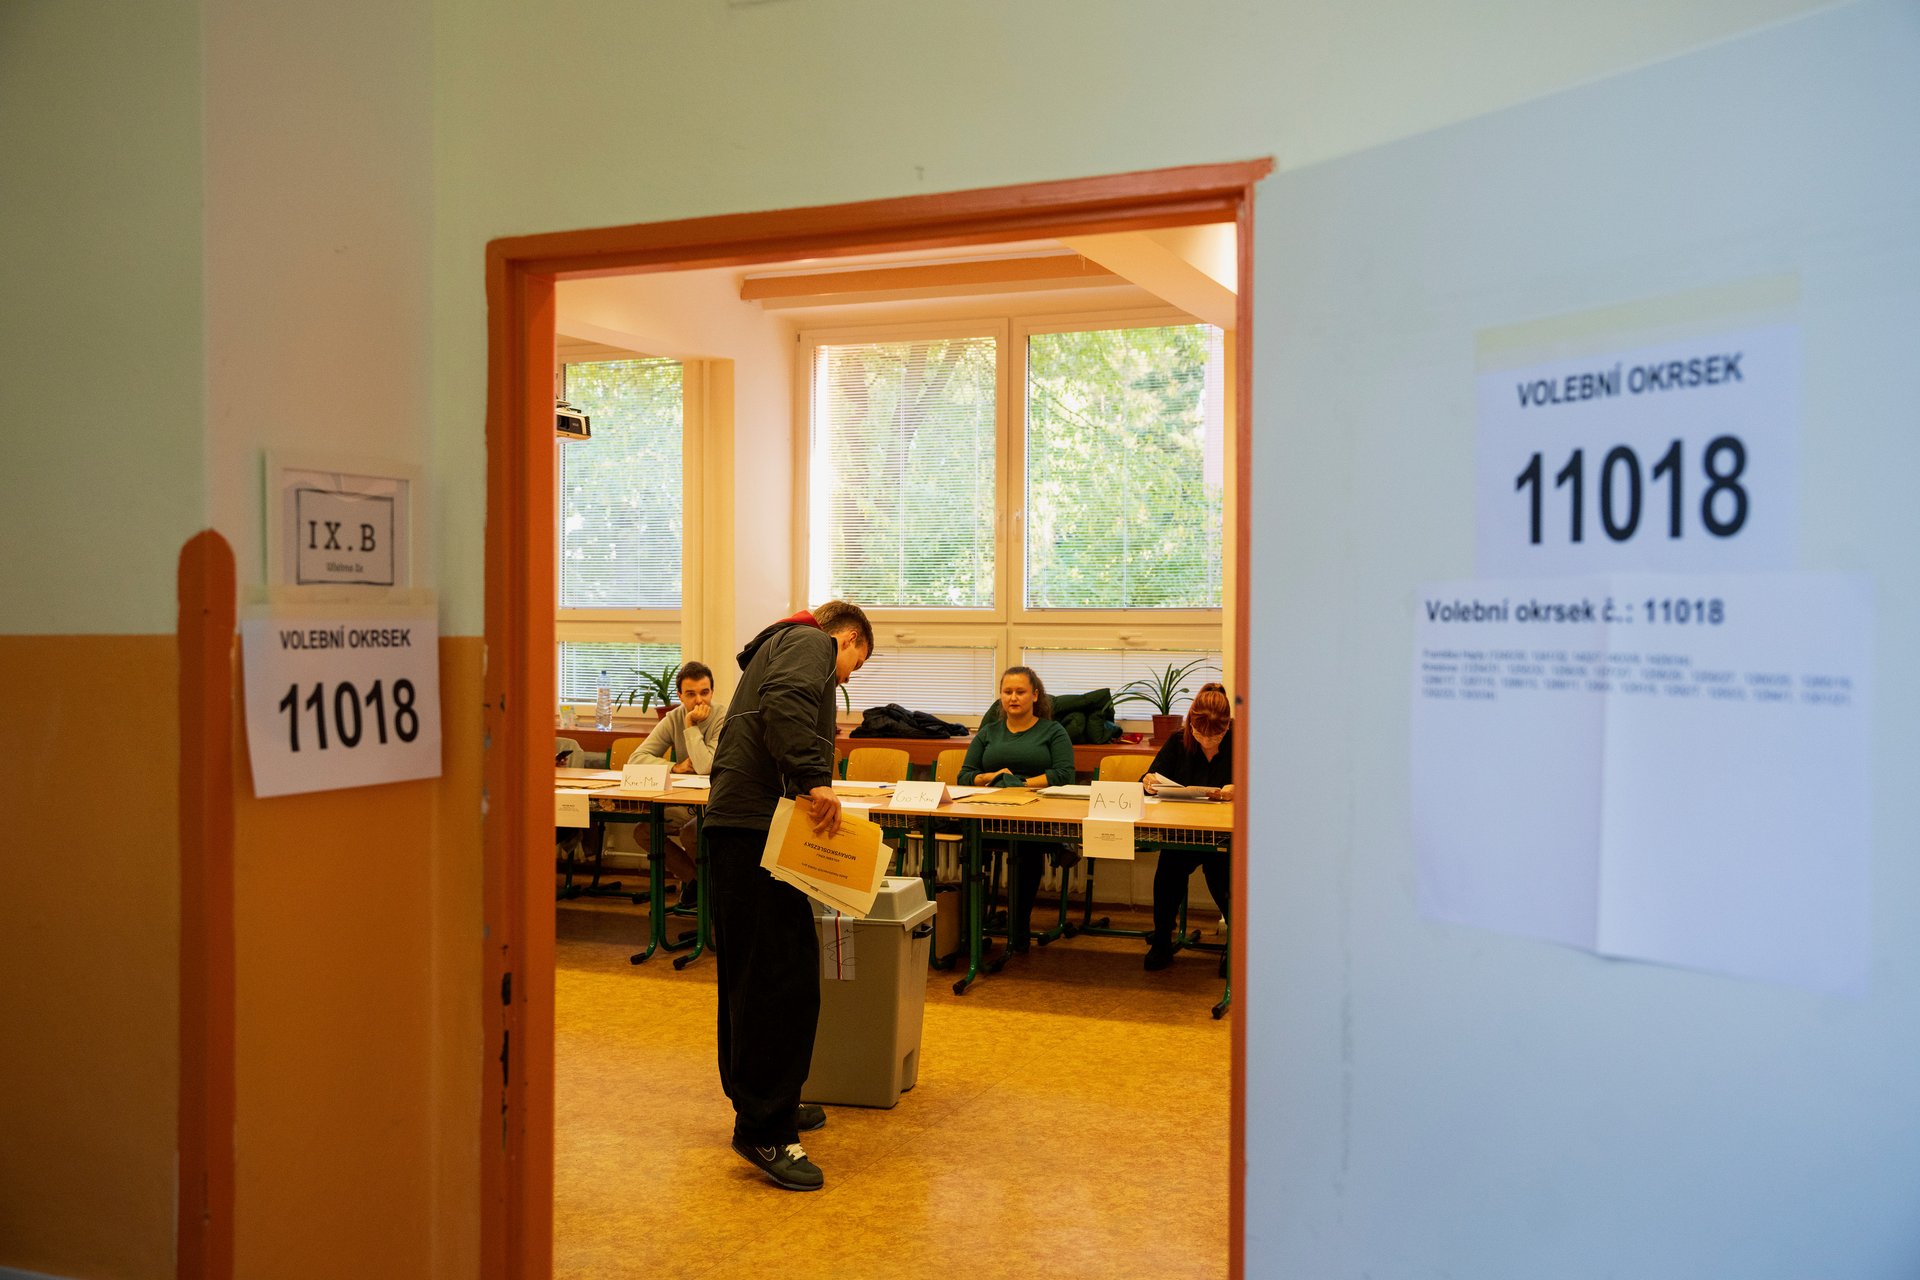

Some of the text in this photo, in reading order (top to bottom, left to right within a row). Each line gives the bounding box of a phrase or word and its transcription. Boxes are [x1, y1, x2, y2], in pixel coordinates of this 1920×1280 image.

[1516, 352, 1744, 408] VOLEBNÍ OKRSEK
[1515, 434, 1750, 545] 11018
[280, 624, 411, 650] VOLEBNÍ OKRSEK
[1425, 598, 1509, 623] Volební
[1514, 598, 1597, 623] okrsek
[1643, 598, 1726, 625] 11018
[279, 677, 420, 753] 11018
